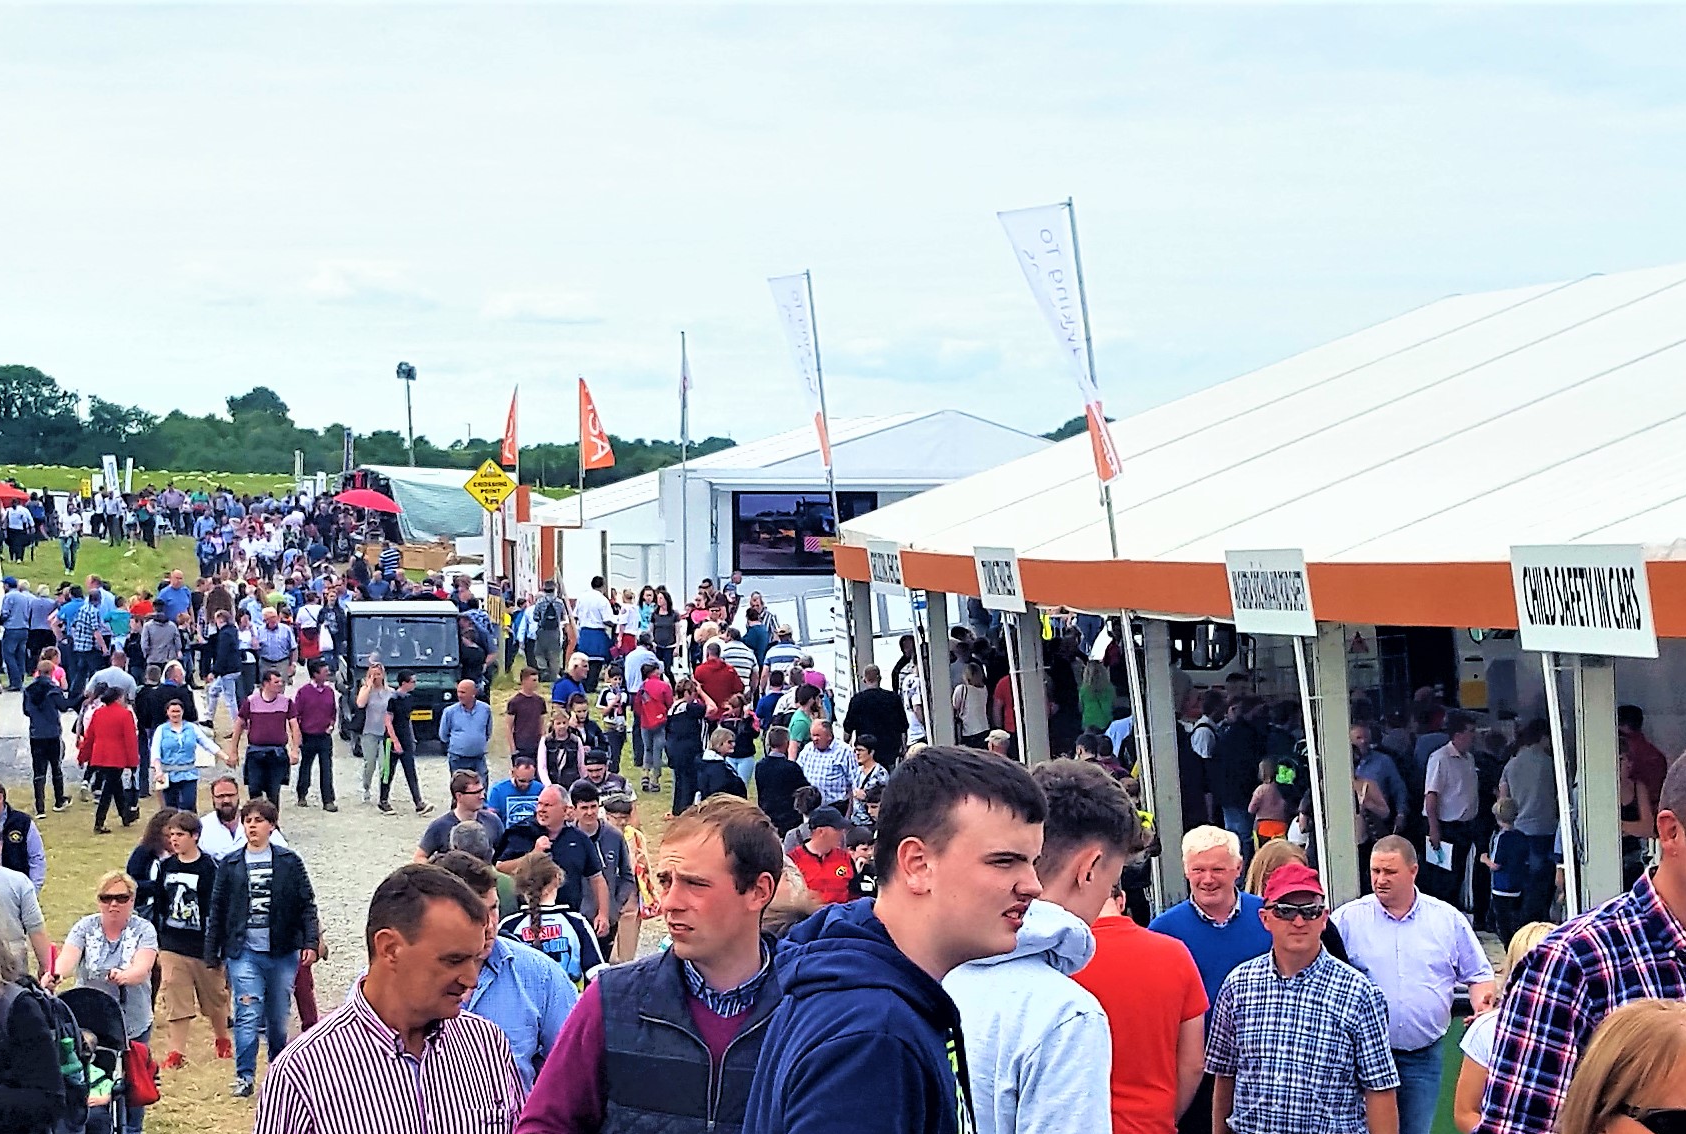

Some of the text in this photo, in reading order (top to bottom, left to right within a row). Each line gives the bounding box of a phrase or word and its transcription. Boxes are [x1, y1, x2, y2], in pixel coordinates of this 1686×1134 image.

[1523, 566, 1556, 626] CHILD
[1554, 566, 1597, 628] SAFETY
[1608, 567, 1641, 631] CARS
